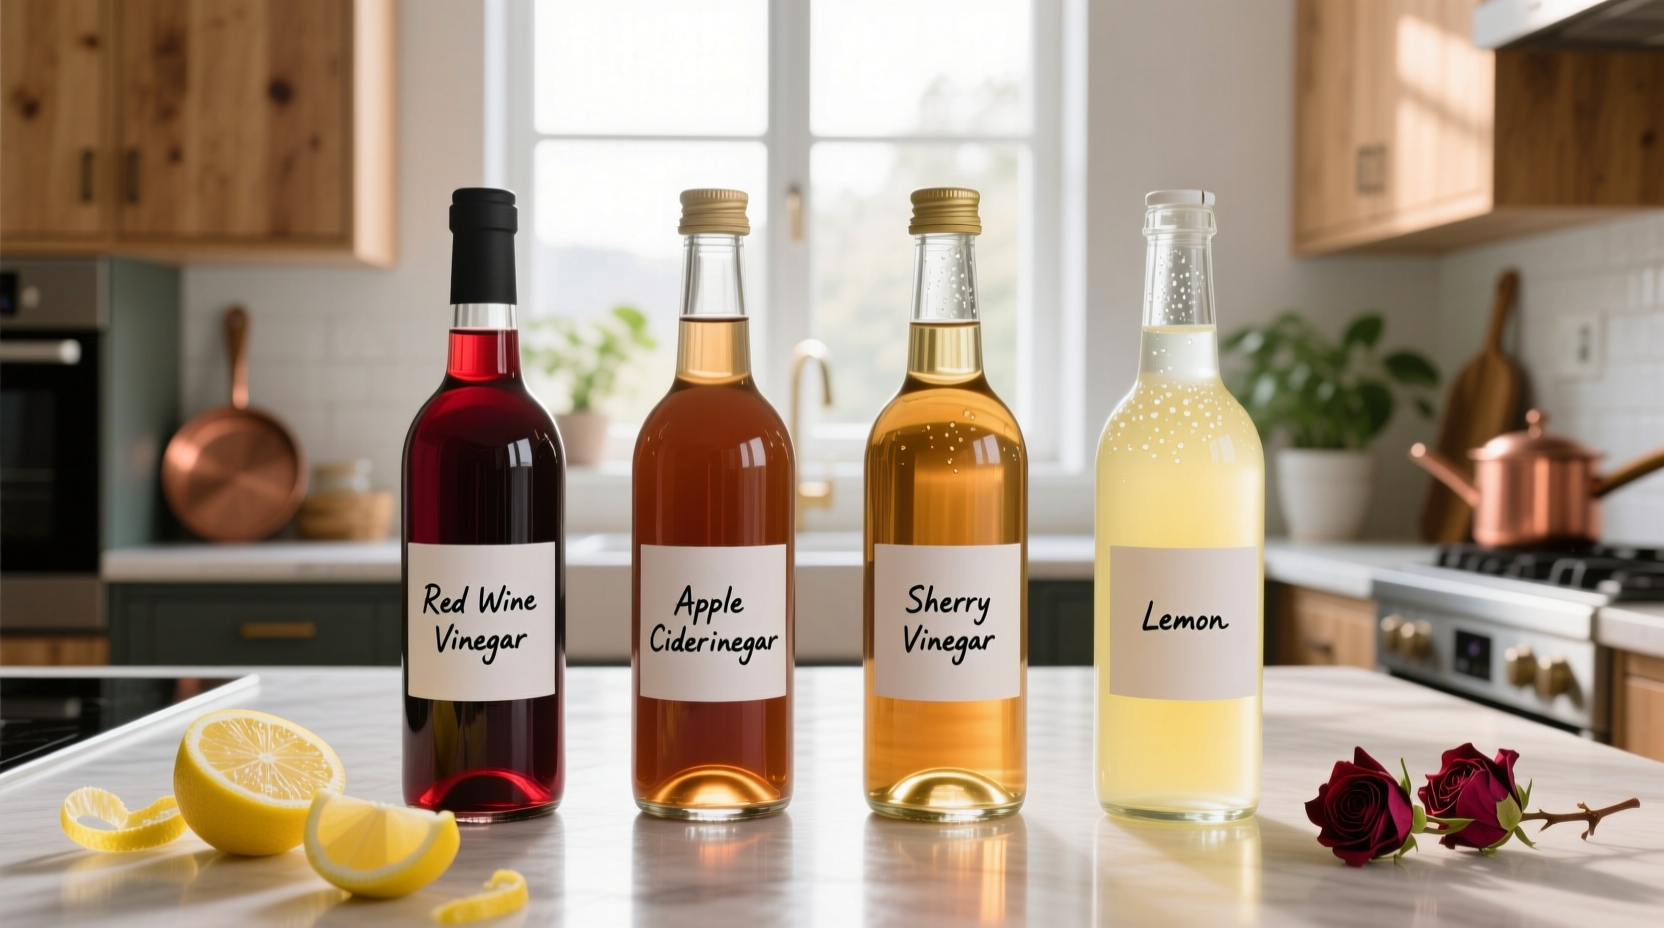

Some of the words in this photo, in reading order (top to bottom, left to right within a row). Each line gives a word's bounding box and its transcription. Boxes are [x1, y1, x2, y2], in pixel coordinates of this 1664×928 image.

[422, 582, 470, 615] Red
[479, 584, 538, 614] Wine
[673, 584, 745, 626] Apple
[905, 584, 991, 626] Sherry
[1141, 599, 1230, 632] Lemon
[435, 623, 528, 666] Vinegar
[649, 623, 779, 666] Ciderinegar
[903, 624, 996, 666] Vinegar
